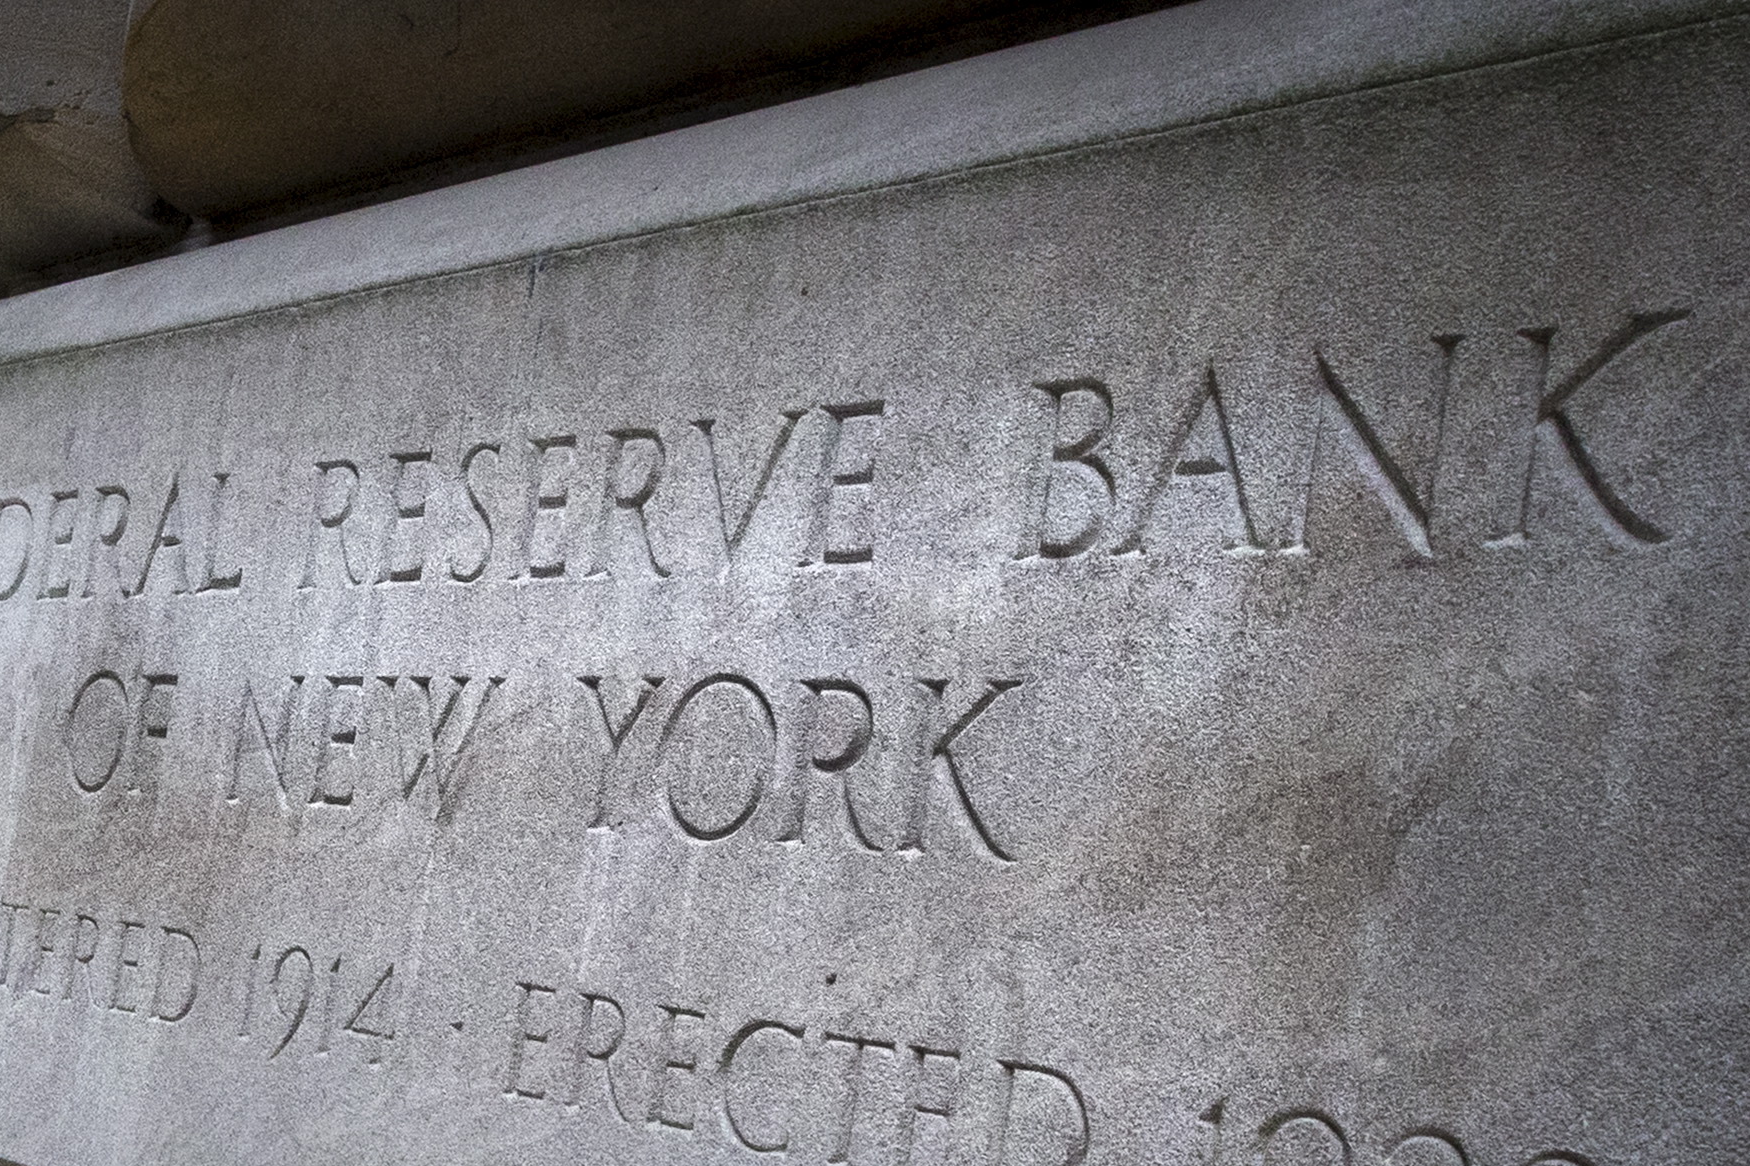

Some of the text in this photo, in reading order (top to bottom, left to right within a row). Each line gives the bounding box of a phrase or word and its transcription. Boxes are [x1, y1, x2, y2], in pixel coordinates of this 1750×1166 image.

[296, 398, 886, 590] RESERVE
[1012, 308, 1692, 564] BANK
[66, 669, 1025, 863] OF NEW YORK
[235, 945, 398, 1066] 1914
